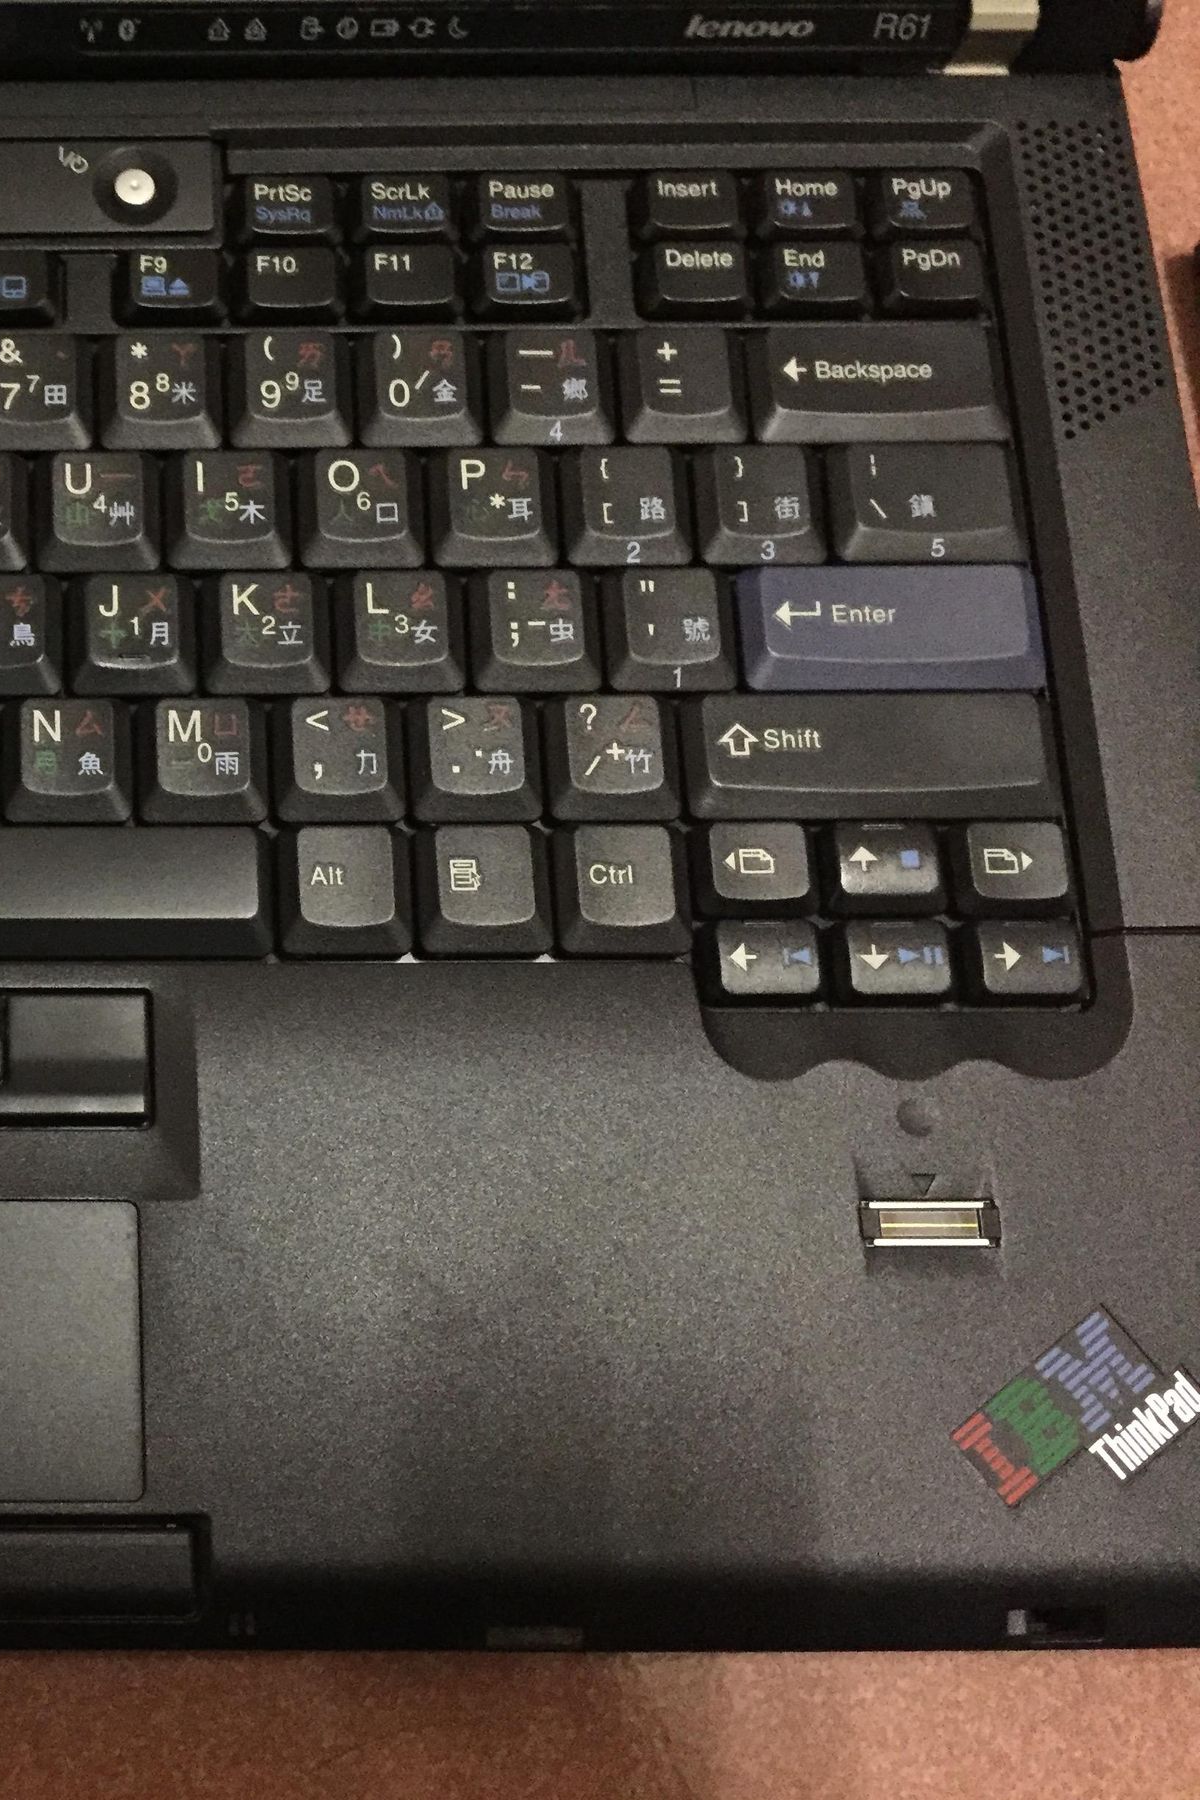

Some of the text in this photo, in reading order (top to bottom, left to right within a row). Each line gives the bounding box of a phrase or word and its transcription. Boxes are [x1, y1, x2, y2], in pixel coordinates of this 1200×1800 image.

[685, 14, 814, 37] lenovo
[874, 12, 931, 40] R61
[255, 184, 311, 202] PrtSc
[372, 182, 429, 200] ScrLk
[489, 181, 554, 198] Pause
[658, 180, 717, 197] Insert
[776, 179, 837, 196] Home
[892, 178, 951, 200] PgUp
[492, 202, 540, 220] Break
[140, 255, 167, 273] F9
[257, 256, 296, 273] F10
[375, 253, 409, 271] F11
[494, 252, 532, 269] F12
[666, 249, 732, 267] Delete
[784, 249, 824, 268] End
[903, 249, 960, 270] PgDn
[0, 339, 22, 363] &
[156, 373, 169, 392] 8
[286, 372, 299, 390] 9
[815, 360, 932, 383] Backspace
[27, 375, 40, 393] 7
[44, 385, 66, 405] 田
[130, 381, 150, 409] 8
[172, 382, 196, 404] 米
[261, 381, 281, 408] 9
[302, 380, 326, 402] 足
[433, 379, 456, 402] 金
[0, 383, 20, 409] 7
[550, 420, 563, 441] 4
[66, 463, 91, 494] U
[328, 460, 359, 492] O
[461, 459, 485, 489] P
[93, 494, 107, 513] 4
[225, 492, 239, 511] 5
[357, 492, 371, 510] 6
[507, 498, 533, 520] 耳
[640, 497, 665, 520] 路
[775, 497, 799, 519] 街
[239, 501, 265, 525] 木
[627, 542, 640, 563] 2
[761, 540, 775, 560] 3
[931, 538, 945, 557] 5
[99, 585, 118, 616] J
[232, 584, 259, 615] K
[366, 583, 389, 614] L
[262, 616, 275, 634] 2
[395, 614, 409, 633] 3
[832, 605, 895, 623] Enter
[10, 623, 35, 646] 鳥
[131, 617, 138, 635] 1
[150, 622, 169, 645] 月
[278, 621, 303, 645] 立
[411, 620, 437, 643] 女
[550, 618, 574, 642] 虫
[683, 617, 710, 642] 號
[674, 667, 681, 688] 1
[33, 710, 61, 742] N
[168, 710, 202, 742] M
[579, 704, 597, 730] ?
[764, 729, 821, 748] Shift
[78, 752, 103, 775] 魚
[215, 752, 239, 775] 雨
[356, 750, 377, 774] 力
[488, 750, 513, 774] 舟
[625, 749, 652, 774] 竹
[311, 867, 343, 885] Alt
[590, 864, 633, 884] Ctrl
[952, 1312, 1155, 1504] IBM
[1089, 1370, 1200, 1480] ThinkPad
